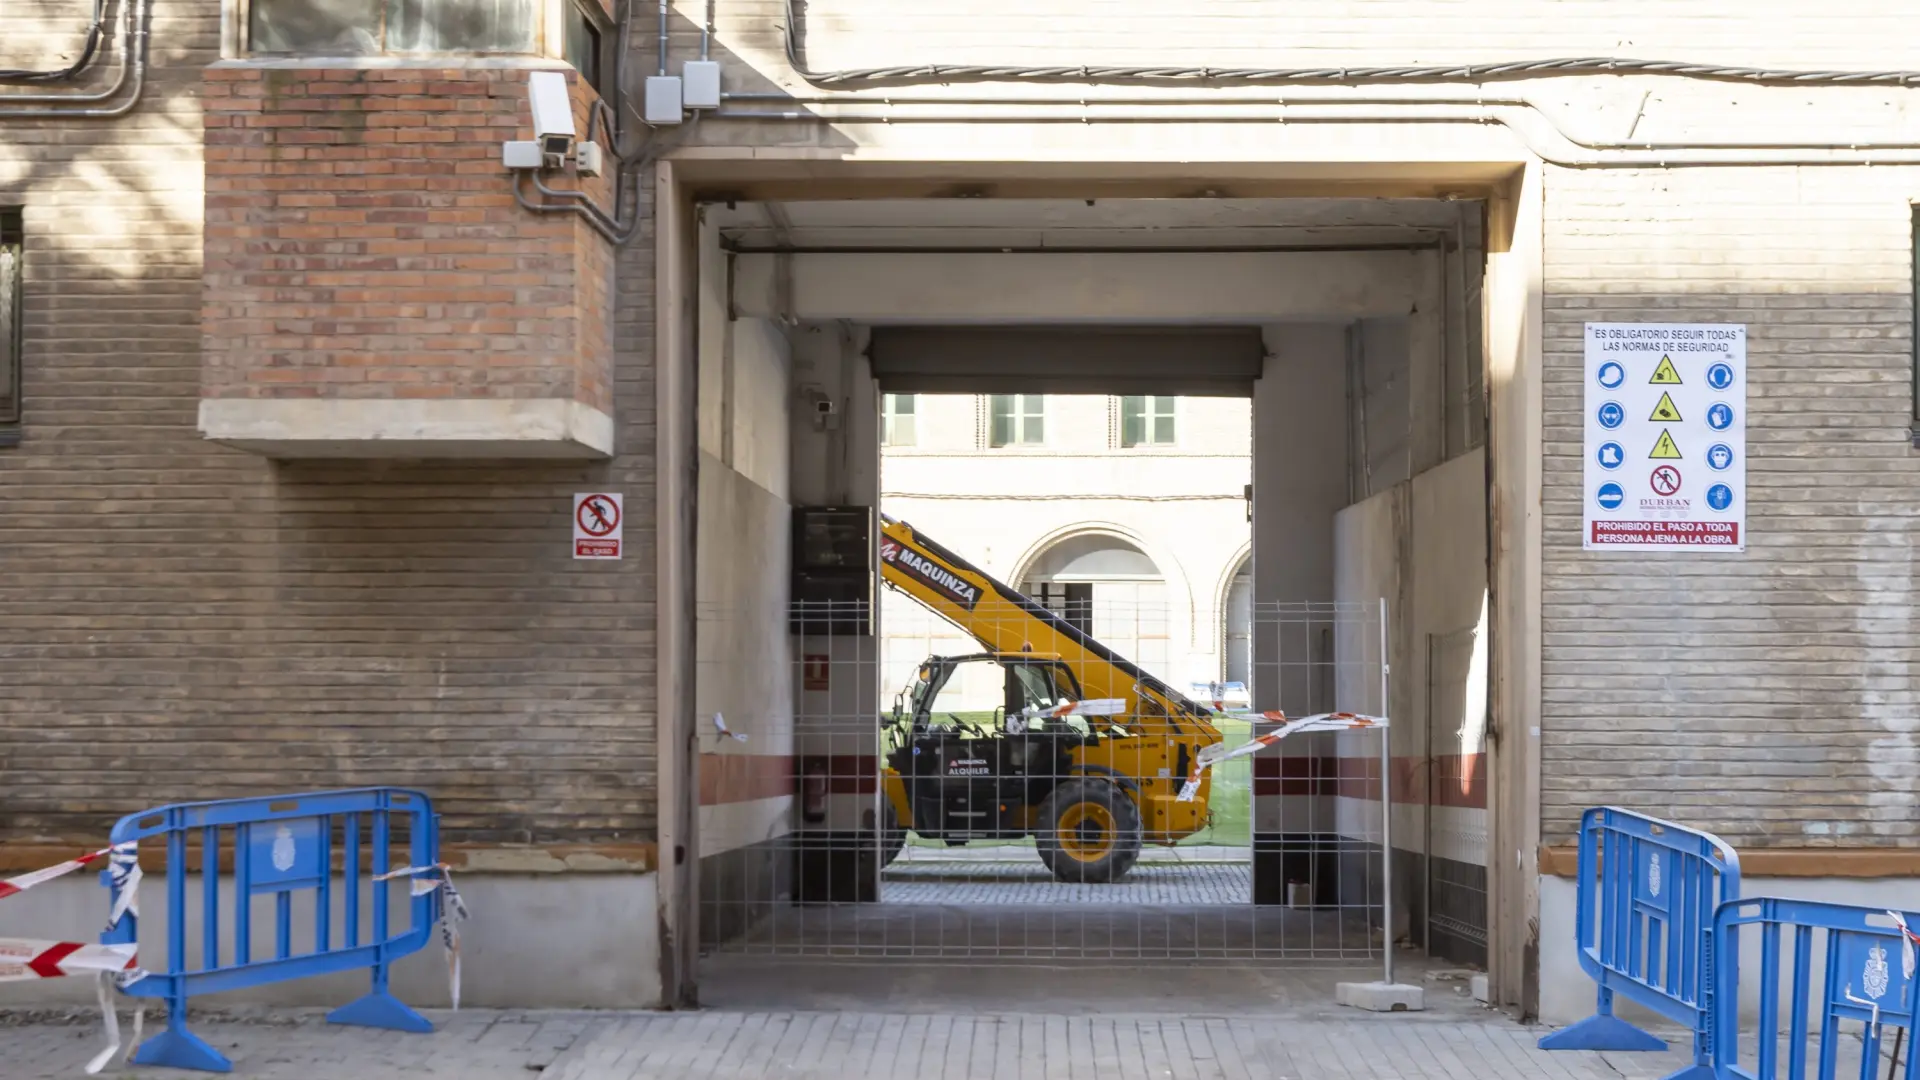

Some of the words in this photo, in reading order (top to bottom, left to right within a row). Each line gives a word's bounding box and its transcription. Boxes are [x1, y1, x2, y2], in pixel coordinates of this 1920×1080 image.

[1595, 329, 1607, 339] ES
[1609, 329, 1669, 339] OBLIGATORIO
[1672, 330, 1704, 340] SEGUIR
[1707, 330, 1737, 340] TODAS
[1603, 342, 1620, 351] LAS
[1622, 342, 1661, 352] NORMAS
[1663, 342, 1675, 352] DE
[1677, 343, 1729, 352] SEGURIDAD
[1597, 522, 1651, 531] PROHIBIDO
[1653, 522, 1666, 531] EL
[1668, 522, 1694, 532] PASO
[1696, 523, 1704, 531] A
[1705, 523, 1733, 532] TODA
[1597, 533, 1644, 543] PERSONA
[1646, 534, 1678, 543] AJENA
[1679, 534, 1688, 543] A
[1689, 535, 1702, 543] LA
[1704, 535, 1733, 544] OBRA
[898, 548, 975, 602] MAQUINZA
[948, 767, 989, 775] ALQUILER
